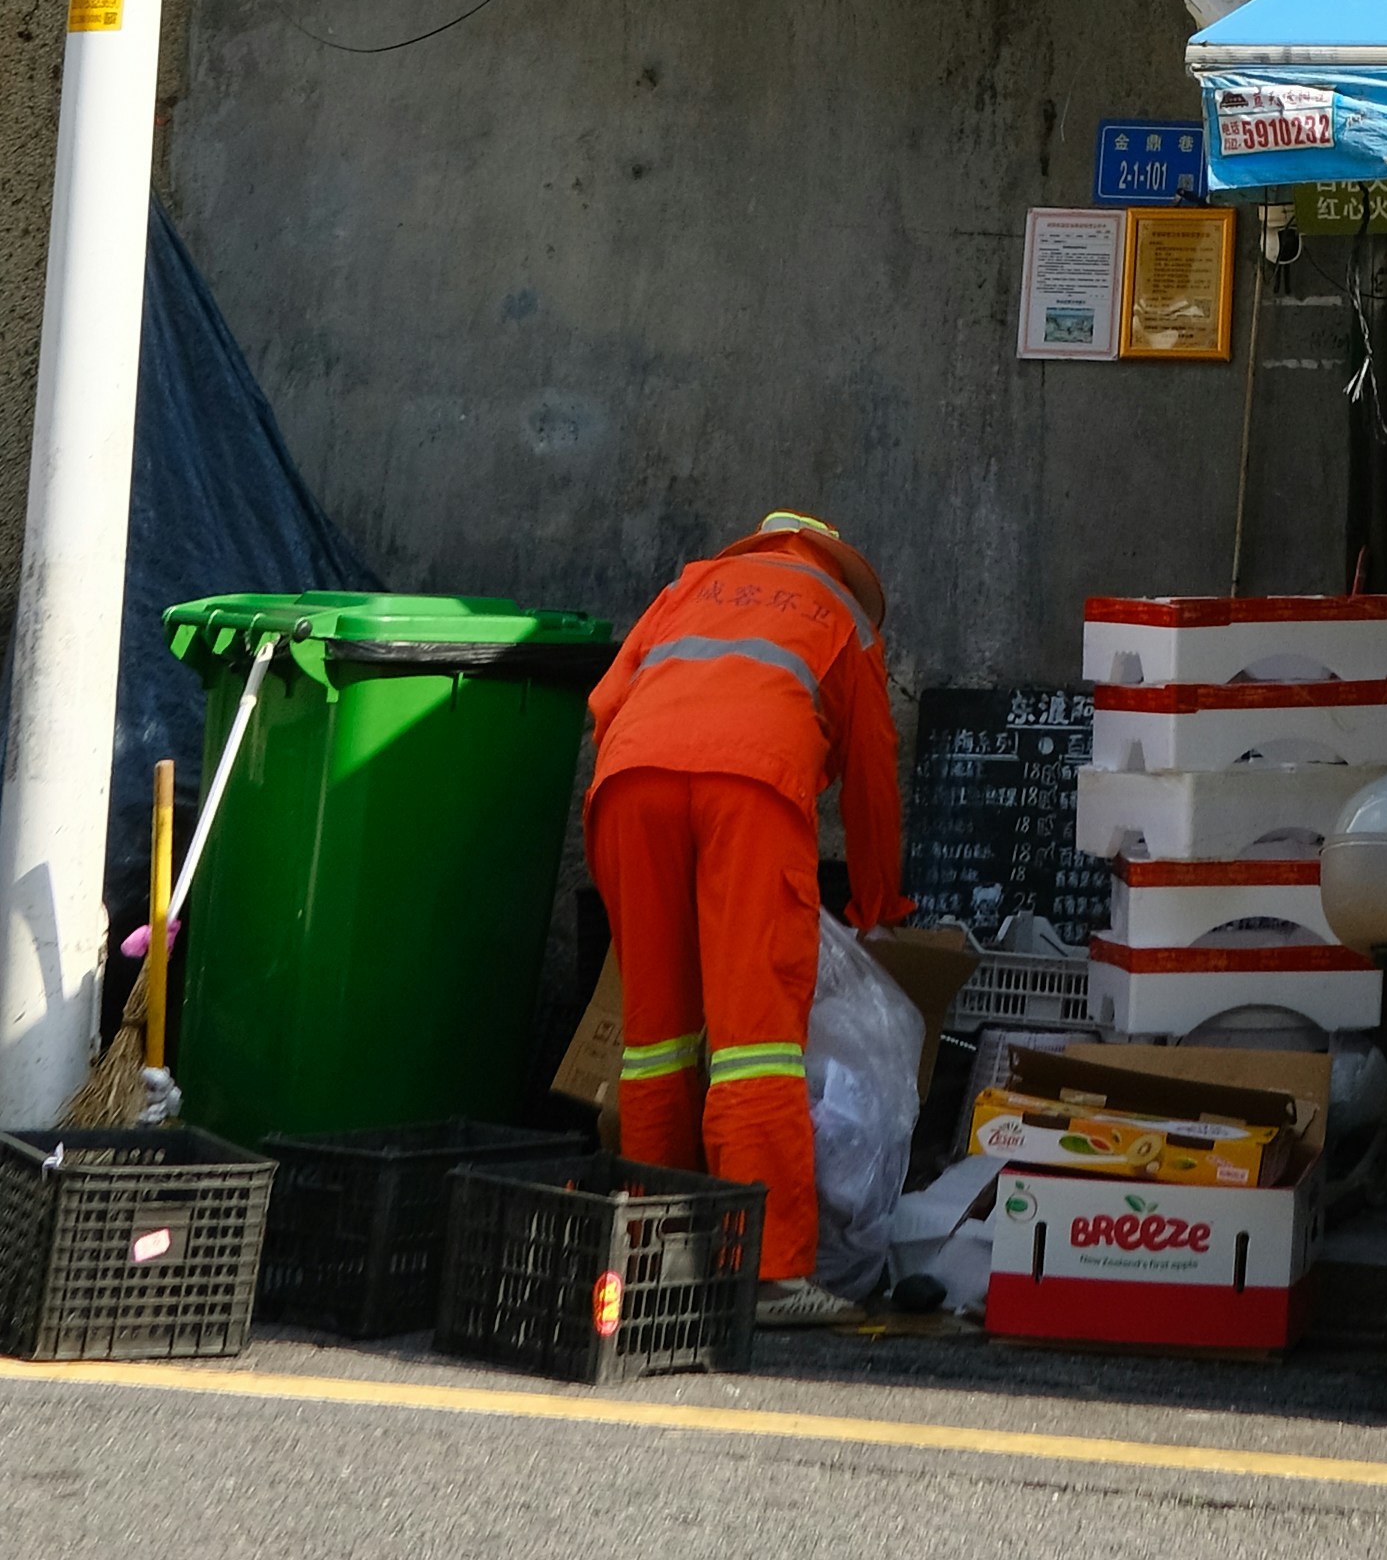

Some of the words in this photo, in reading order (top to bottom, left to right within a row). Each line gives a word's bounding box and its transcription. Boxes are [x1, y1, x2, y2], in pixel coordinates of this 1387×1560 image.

[1114, 132, 1195, 152] 金鼎巷
[1241, 113, 1332, 150] 5910232
[1118, 160, 1168, 191] 2-1-101
